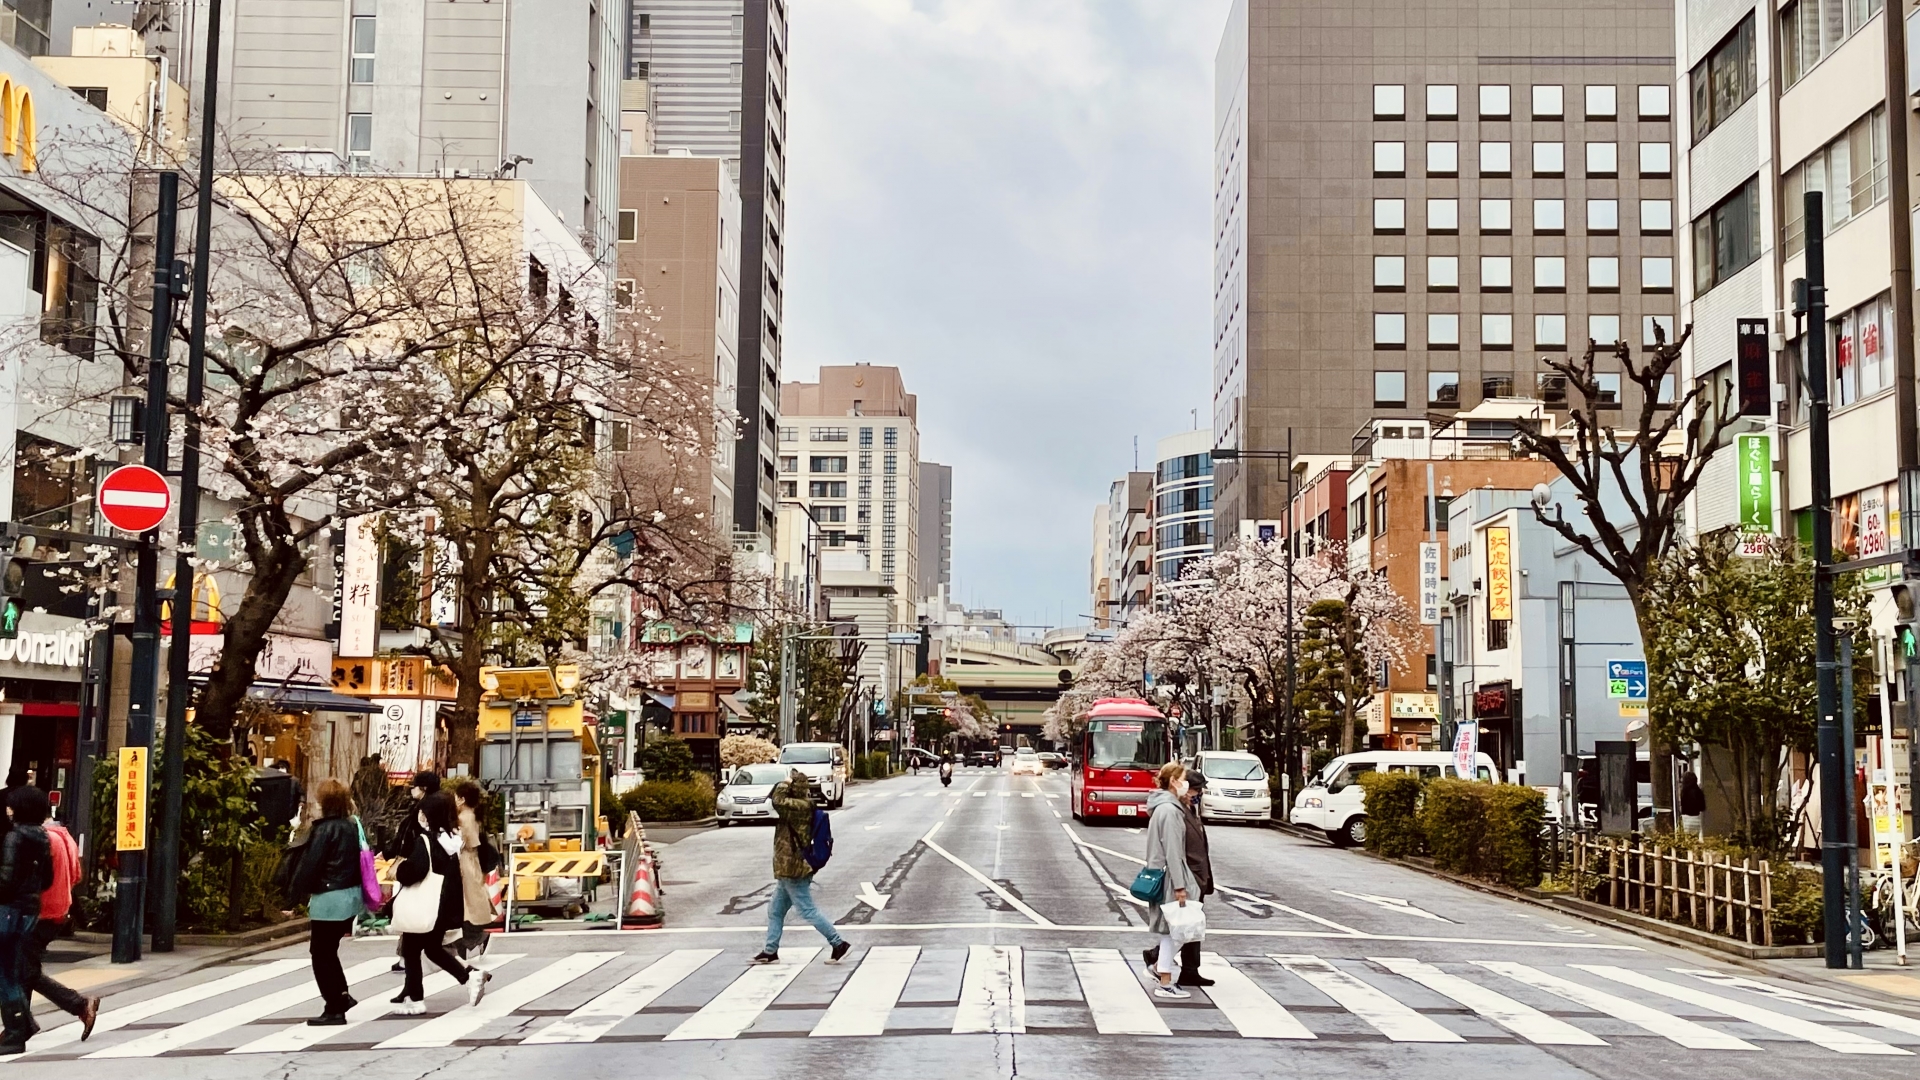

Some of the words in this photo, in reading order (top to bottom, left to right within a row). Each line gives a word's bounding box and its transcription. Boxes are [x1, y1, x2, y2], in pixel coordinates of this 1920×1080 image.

[1838, 323, 1877, 369] 麻雀
[1424, 546, 1437, 620] 佐野時計店
[1489, 536, 1510, 611] 紅虎餃子房
[125, 770, 138, 839] 自転車は歩道へ
